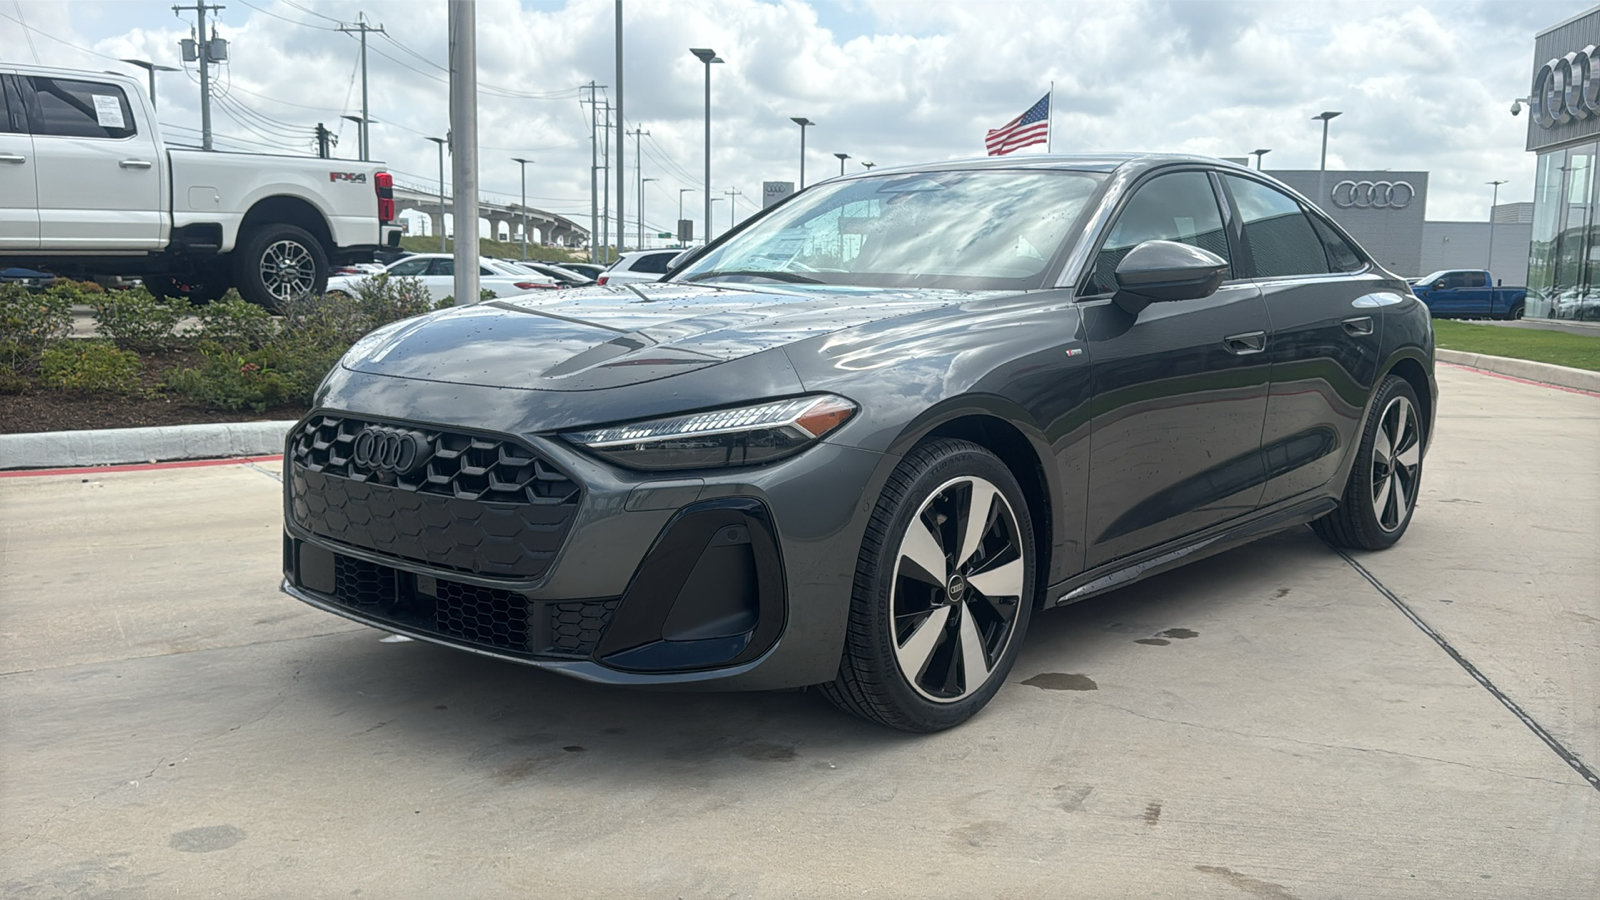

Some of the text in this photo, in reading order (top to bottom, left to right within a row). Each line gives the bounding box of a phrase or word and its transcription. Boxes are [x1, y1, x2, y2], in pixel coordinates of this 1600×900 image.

[329, 172, 367, 182] FX4
[929, 454, 973, 476] TURANZA
[877, 579, 897, 678] BRIDGESTONE
